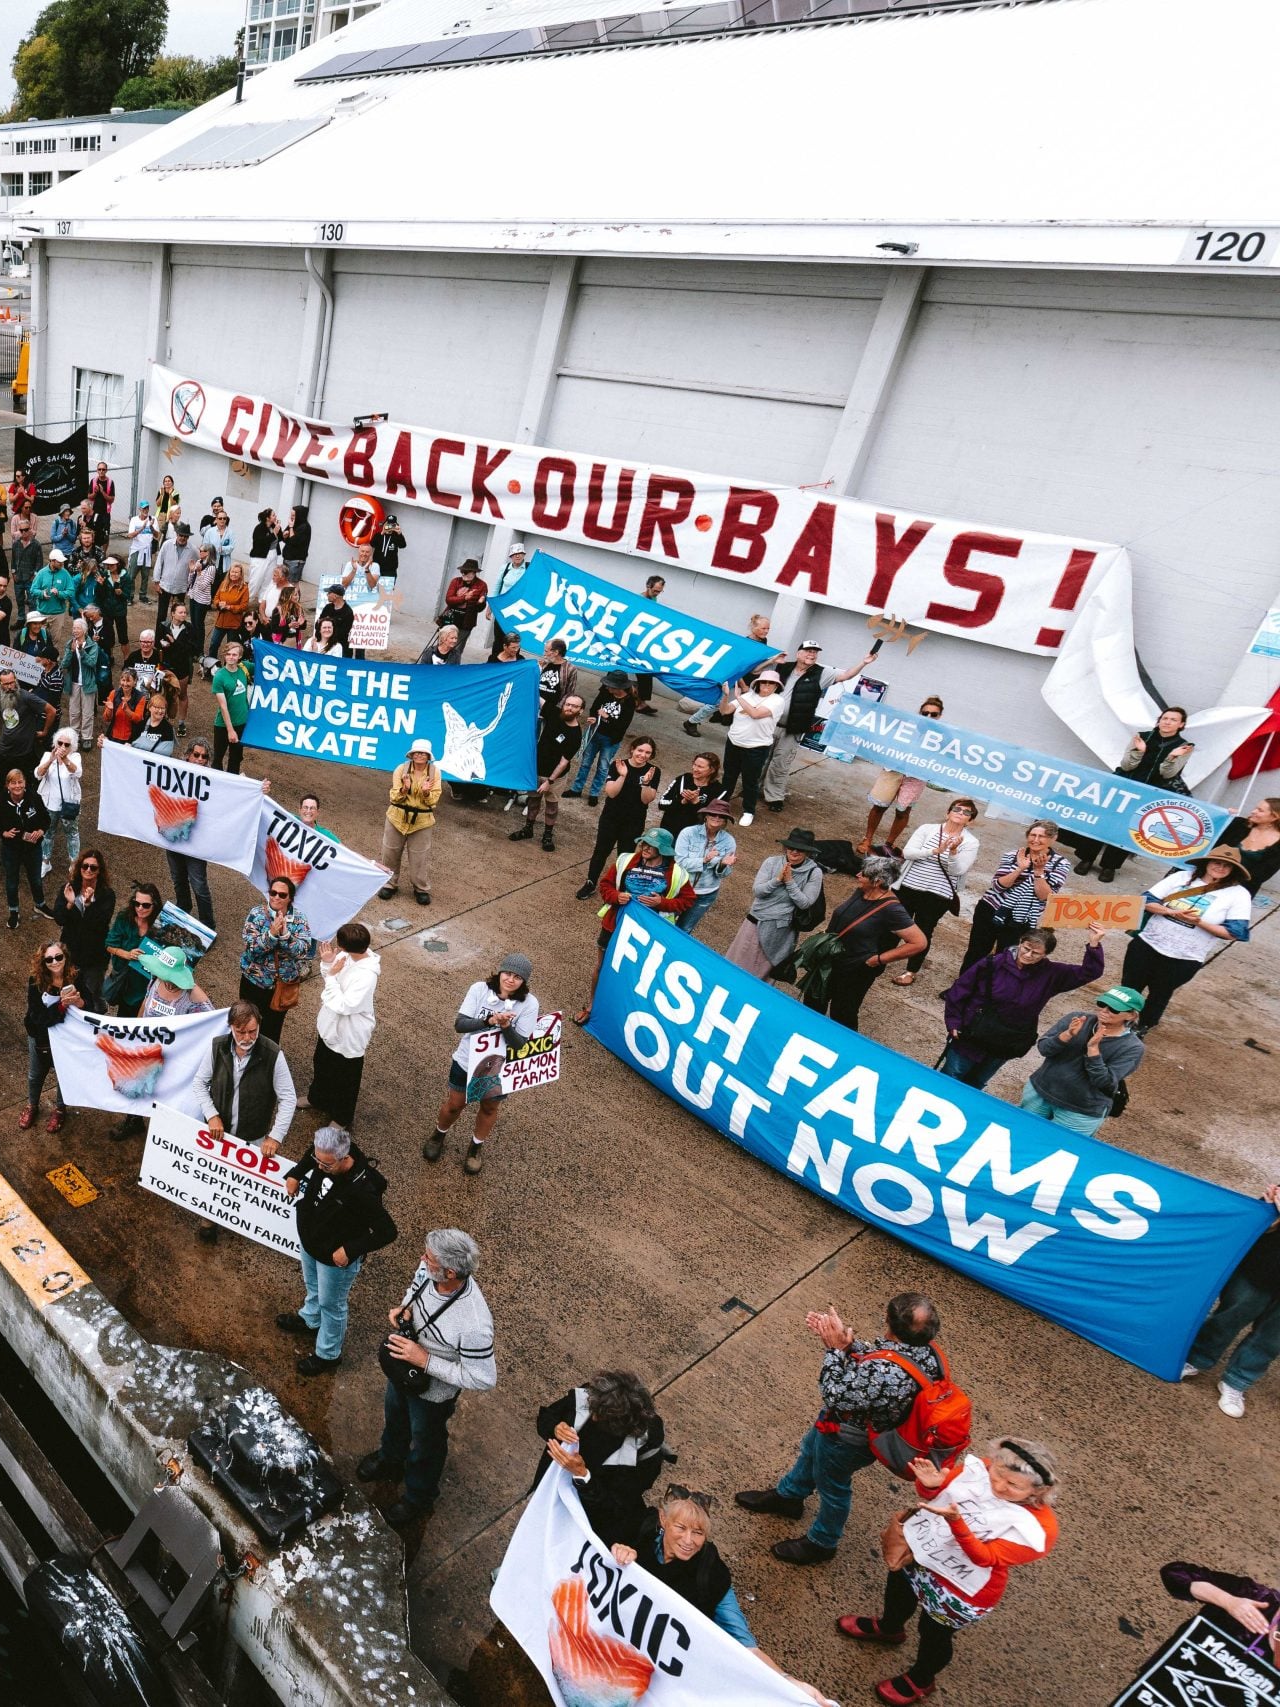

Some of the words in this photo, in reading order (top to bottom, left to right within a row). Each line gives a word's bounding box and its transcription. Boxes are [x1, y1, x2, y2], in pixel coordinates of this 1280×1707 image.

[56, 221, 71, 235] 137
[320, 224, 343, 242] 130
[1195, 231, 1266, 262] 120
[221, 395, 335, 479] GIVE
[343, 426, 512, 520] BACK
[531, 456, 696, 559] OUR
[710, 486, 1097, 649] BAYS!
[352, 624, 387, 632] ASMANIAN
[353, 613, 368, 623] AY
[370, 614, 387, 624] NO
[544, 571, 629, 639] VOTE
[620, 612, 732, 678] FISH
[0, 647, 27, 660] STOP
[349, 638, 385, 647] ALMON!
[262, 654, 337, 691] SAVE
[346, 669, 411, 701] THE
[250, 686, 417, 735] MAUGEAN
[275, 721, 378, 760] SKATE
[840, 704, 916, 744] SAVE
[920, 729, 1007, 774] BASS
[1012, 760, 1140, 814] STRAIT
[142, 759, 211, 802] TOXIC
[851, 733, 1099, 826] www.nwtasforcleanoceans.org.au
[1141, 800, 1166, 813] NWTAS
[1179, 801, 1200, 814] CLEAN
[266, 810, 338, 871] TOXIC
[1052, 896, 1132, 923] TOXIC
[502, 1051, 558, 1078] SALMON
[513, 1066, 557, 1091] FARMS
[610, 913, 760, 1066] FISH
[767, 1032, 1162, 1241] FARMS
[152, 1134, 194, 1162] USING
[197, 1156, 228, 1178] OUR
[195, 1129, 281, 1175] STOP
[623, 1010, 771, 1140] OUT
[786, 1120, 1060, 1267] NOW
[172, 1160, 189, 1174] AS
[193, 1170, 240, 1198] SEPTIC
[244, 1191, 291, 1219] TANKS
[212, 1192, 241, 1212] FOR
[149, 1175, 187, 1202] TOXIC
[191, 1195, 252, 1231] SALMON
[254, 1225, 301, 1254] FARMS
[570, 1540, 691, 1677] TOXIC
[1199, 1635, 1275, 1694] Maugean
